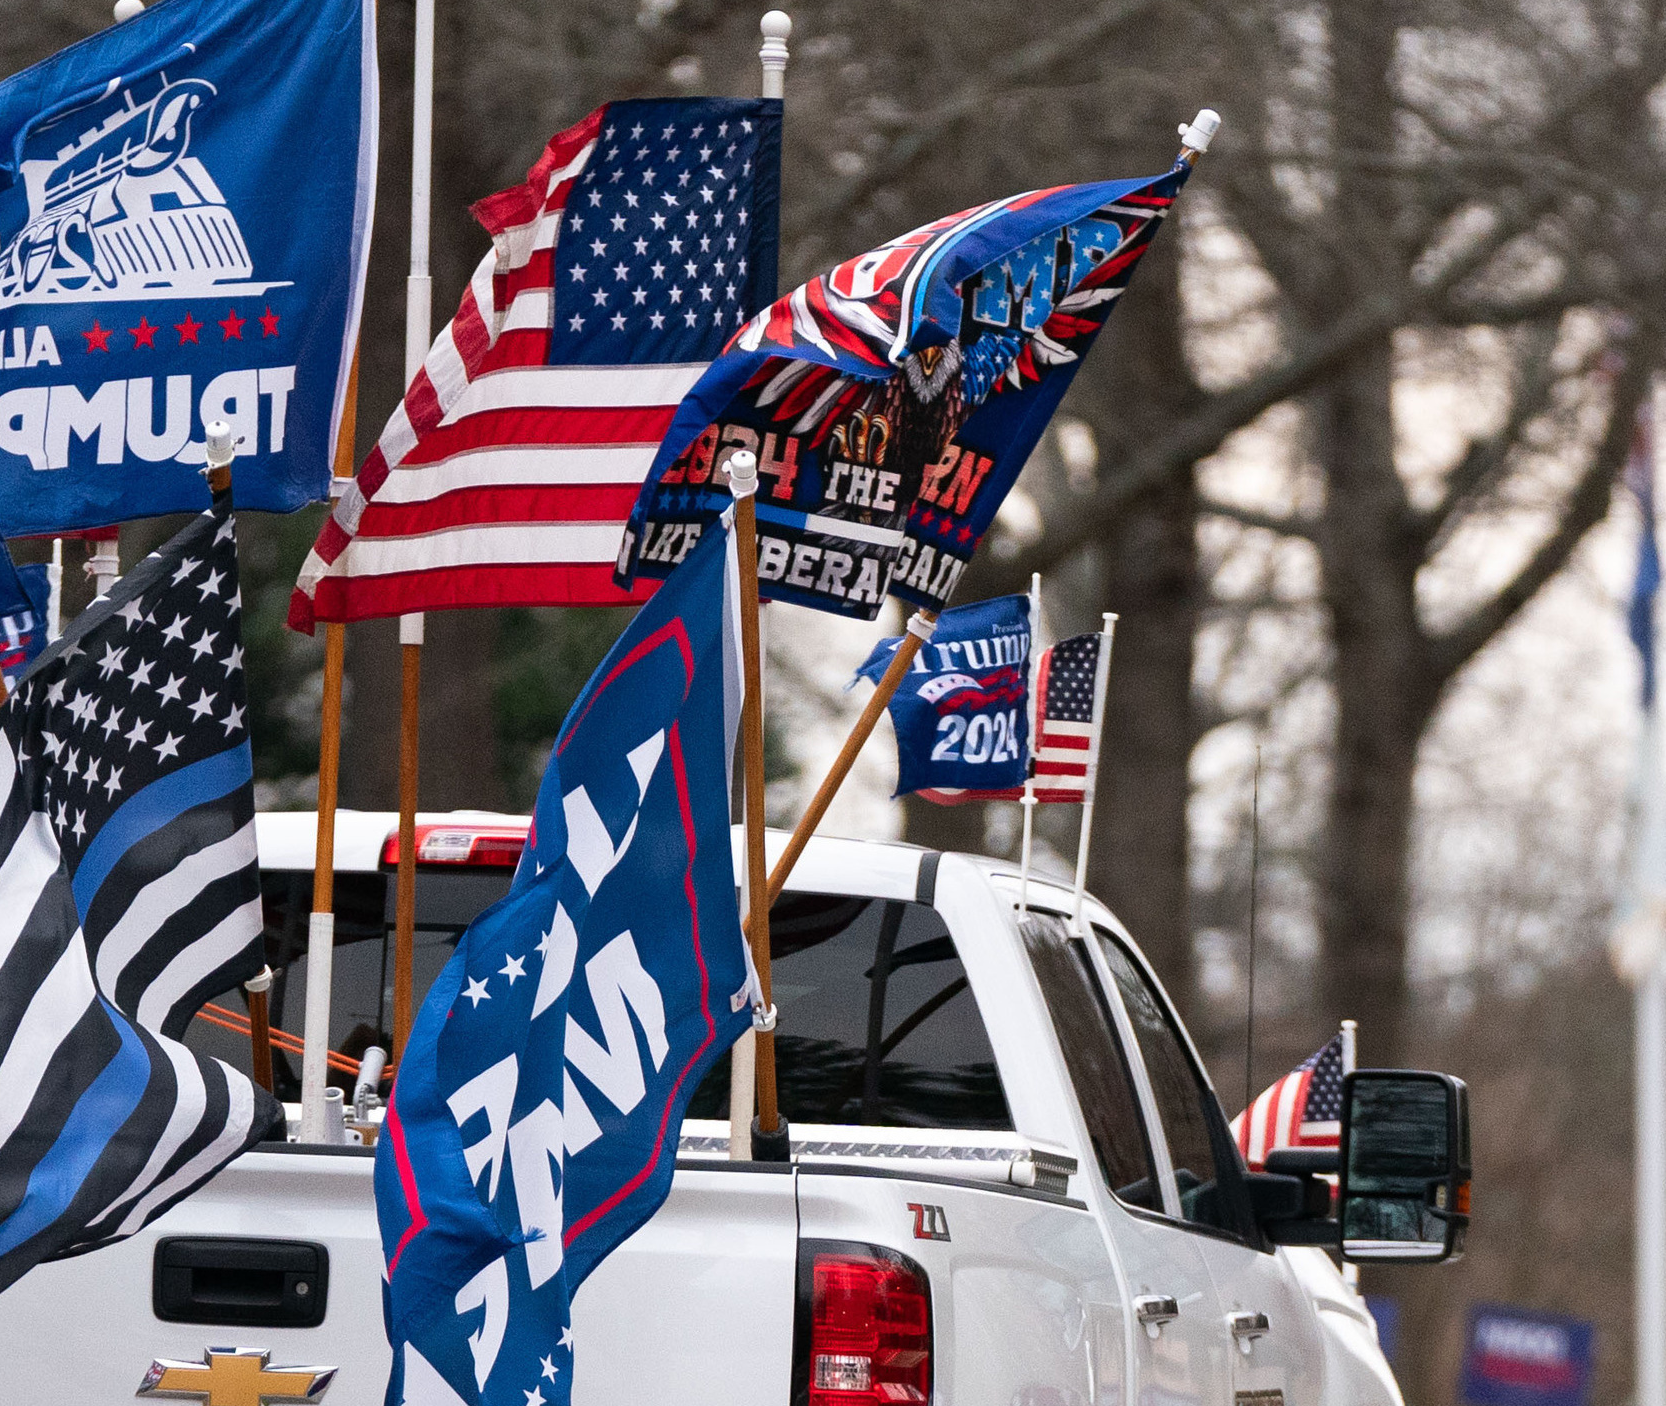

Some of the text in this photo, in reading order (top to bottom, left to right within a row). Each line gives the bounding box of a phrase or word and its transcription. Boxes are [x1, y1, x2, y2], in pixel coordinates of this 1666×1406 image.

[824, 460, 902, 513] THE
[892, 536, 967, 601] GAIN
[931, 709, 1018, 764] 2024
